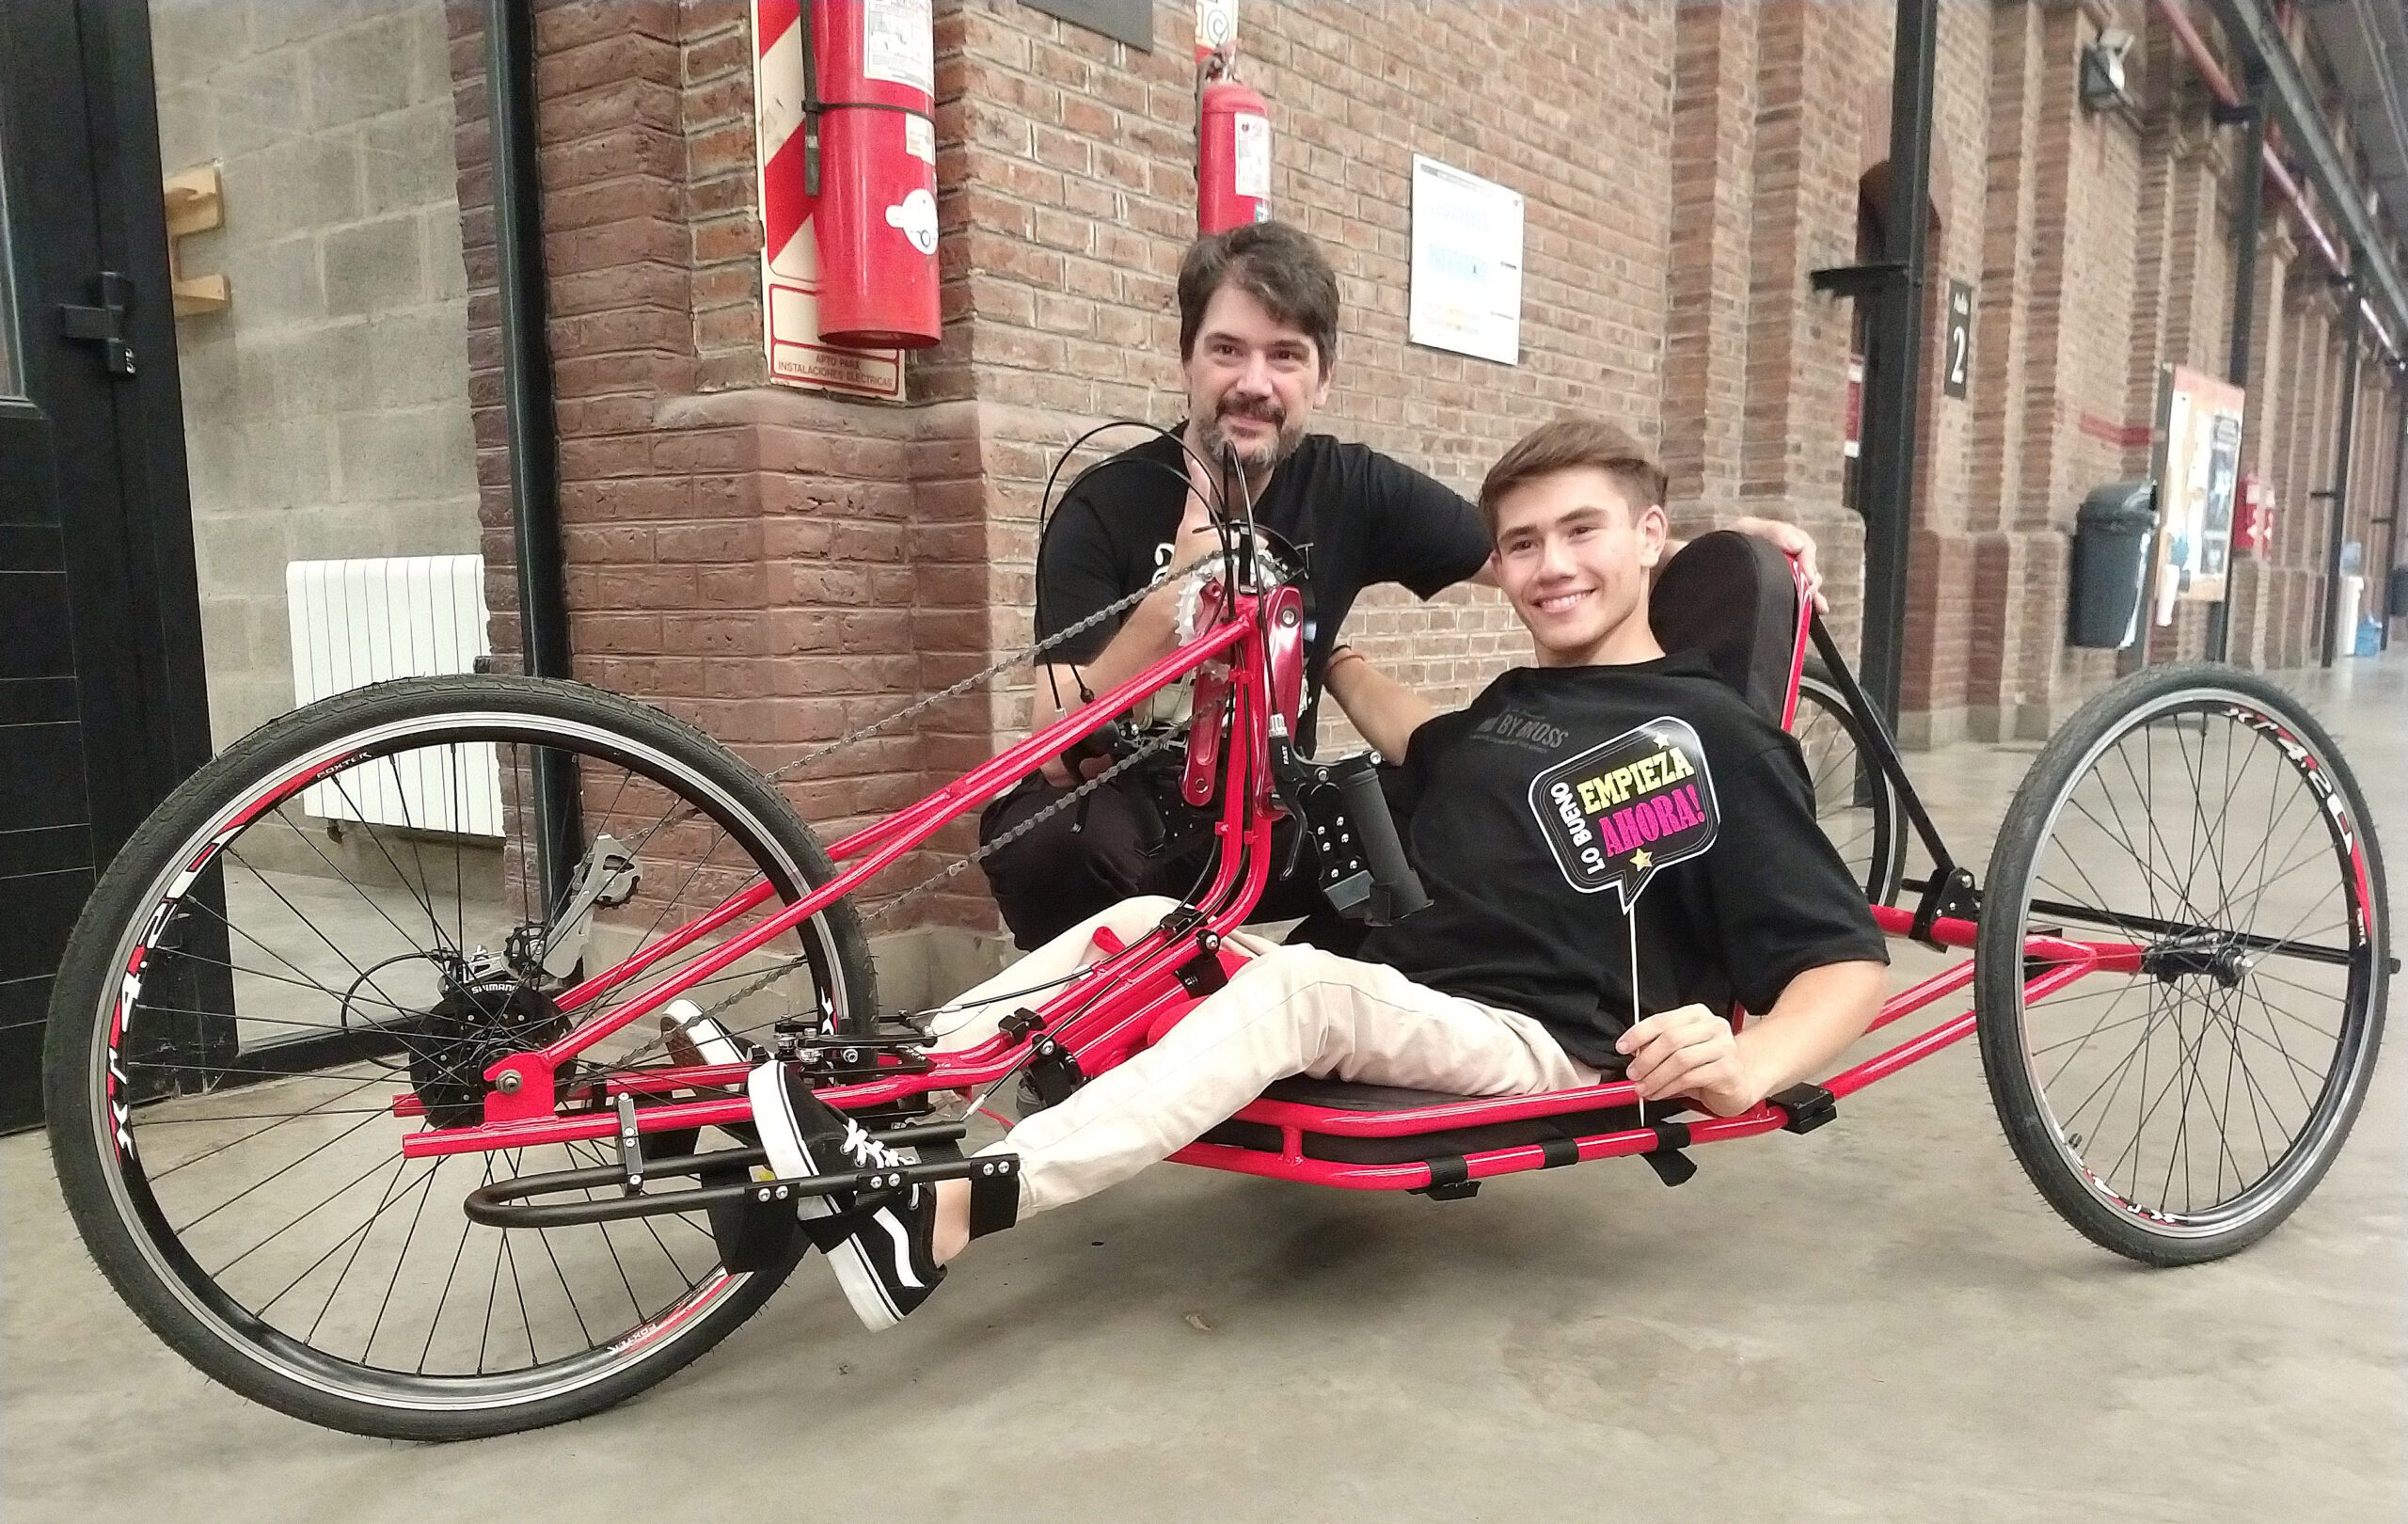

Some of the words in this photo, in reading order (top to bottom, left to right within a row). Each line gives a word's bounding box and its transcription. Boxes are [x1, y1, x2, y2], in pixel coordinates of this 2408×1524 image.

[778, 360, 845, 380] INSTALACIONES
[1951, 325, 1966, 384] 2
[316, 752, 373, 780] FOXTER
[1576, 746, 1696, 816] EMPIEZA
[1551, 782, 1593, 848] BUENO
[1598, 784, 1705, 858] AHORA!
[1580, 847, 1607, 876] LO
